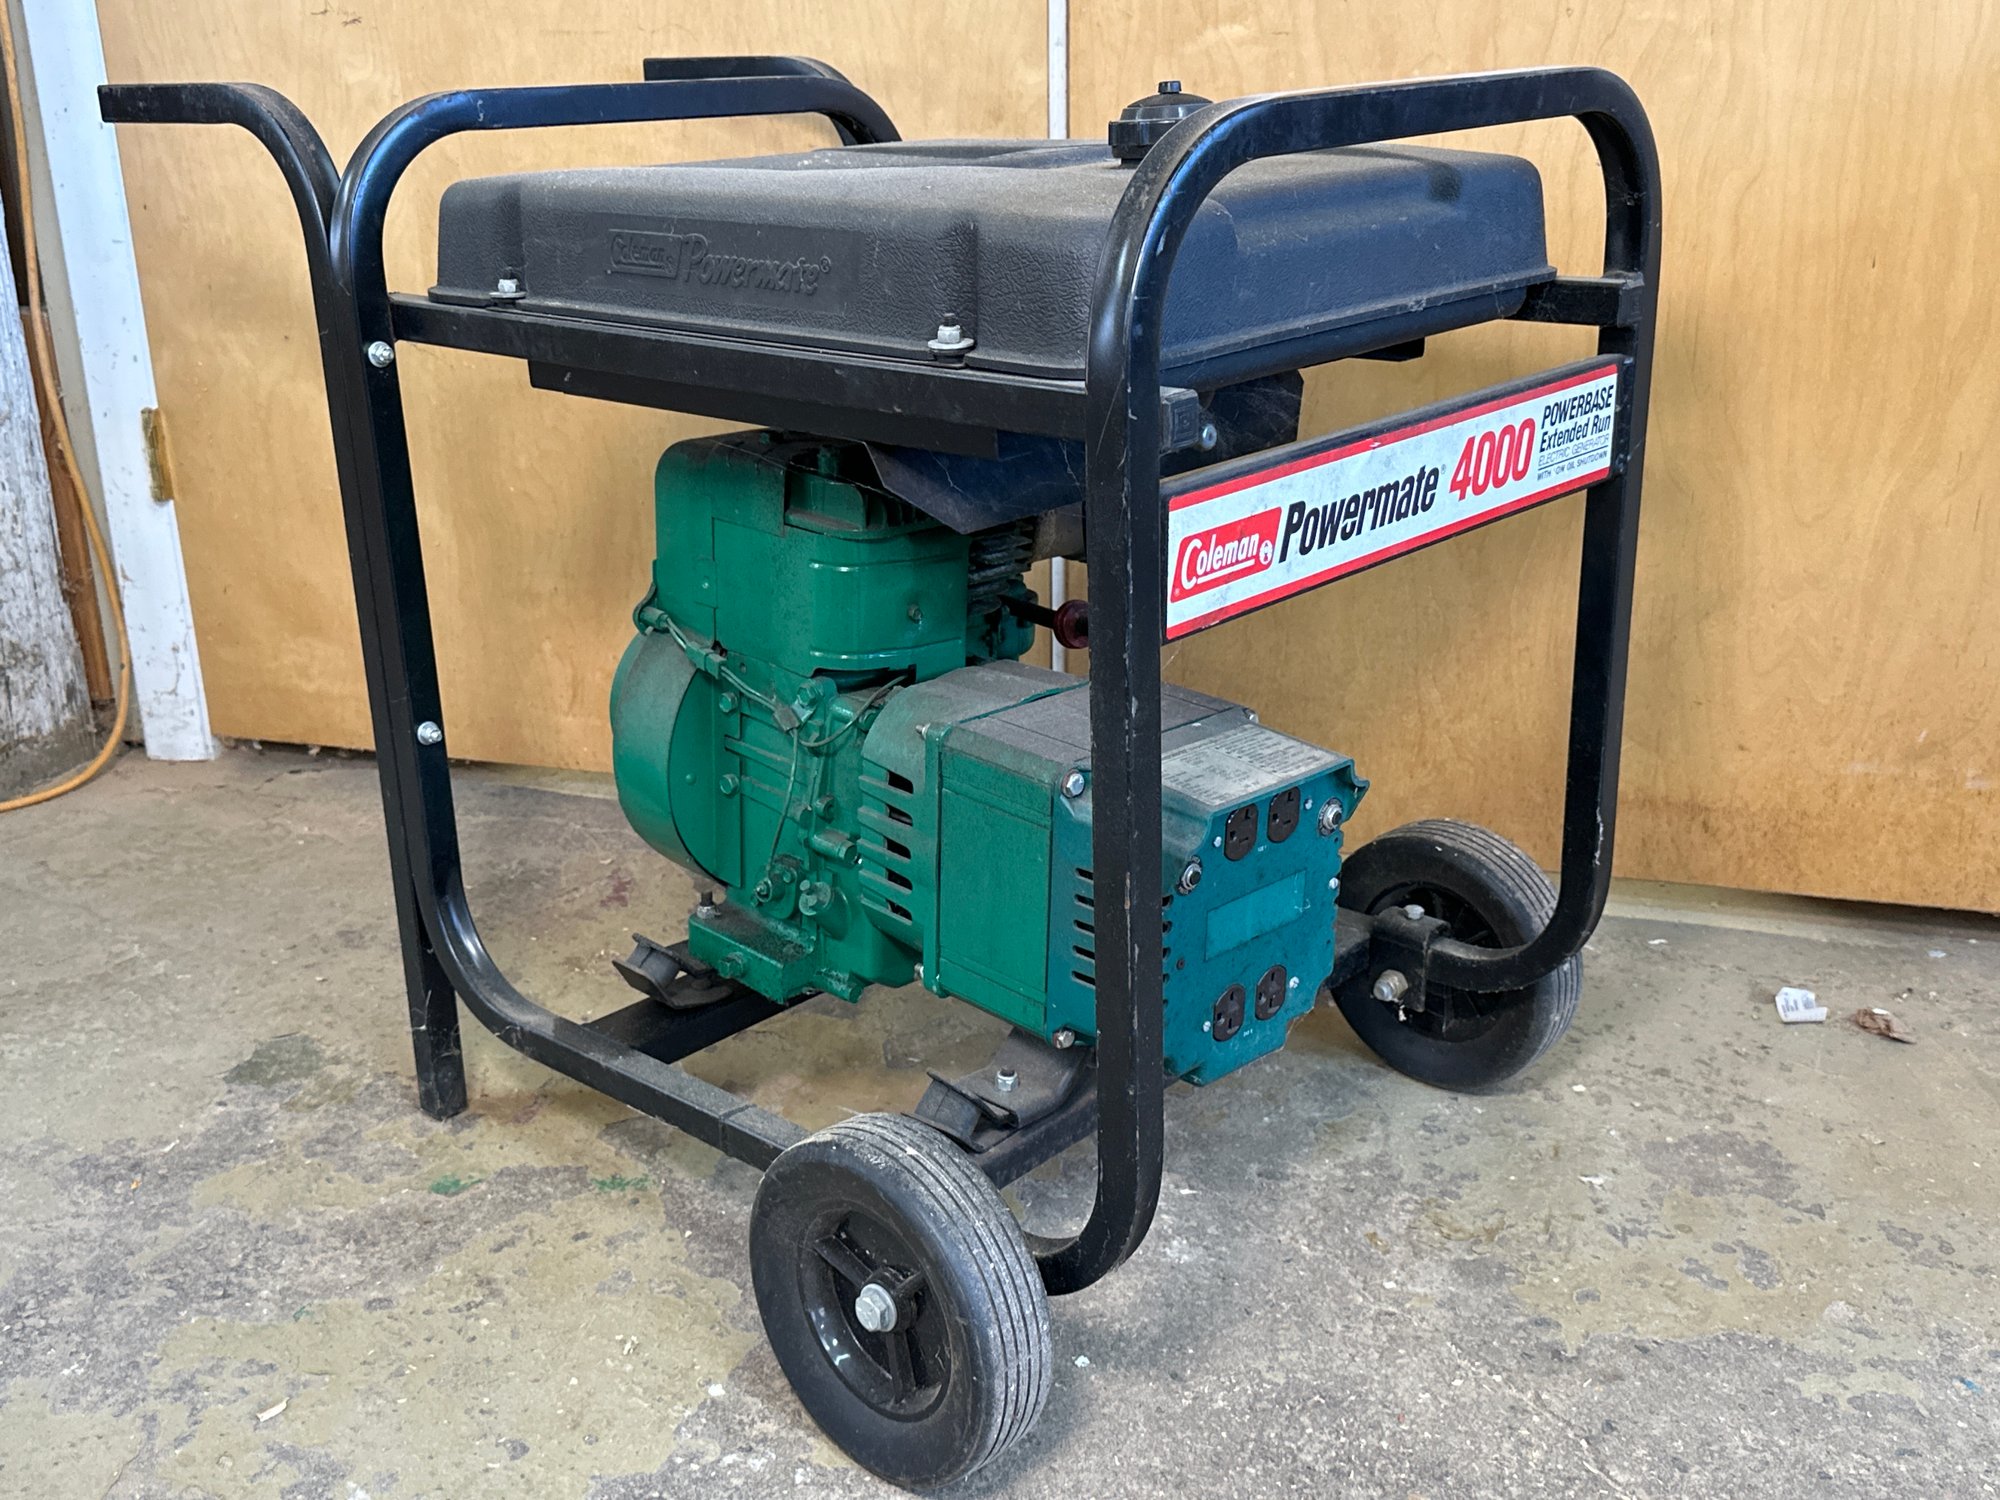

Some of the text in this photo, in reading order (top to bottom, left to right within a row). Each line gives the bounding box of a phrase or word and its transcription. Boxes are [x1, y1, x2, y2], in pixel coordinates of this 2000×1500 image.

[684, 233, 821, 296] Powermate
[1540, 384, 1615, 430] POWERBASE
[1537, 433, 1610, 467] ELECTRIC GENERATOR
[1539, 414, 1612, 454] Extended Run
[1536, 469, 1553, 481] WITH
[1576, 450, 1609, 468] SHUTDOWN
[1181, 417, 1536, 590] Coleman Powermate 4000
